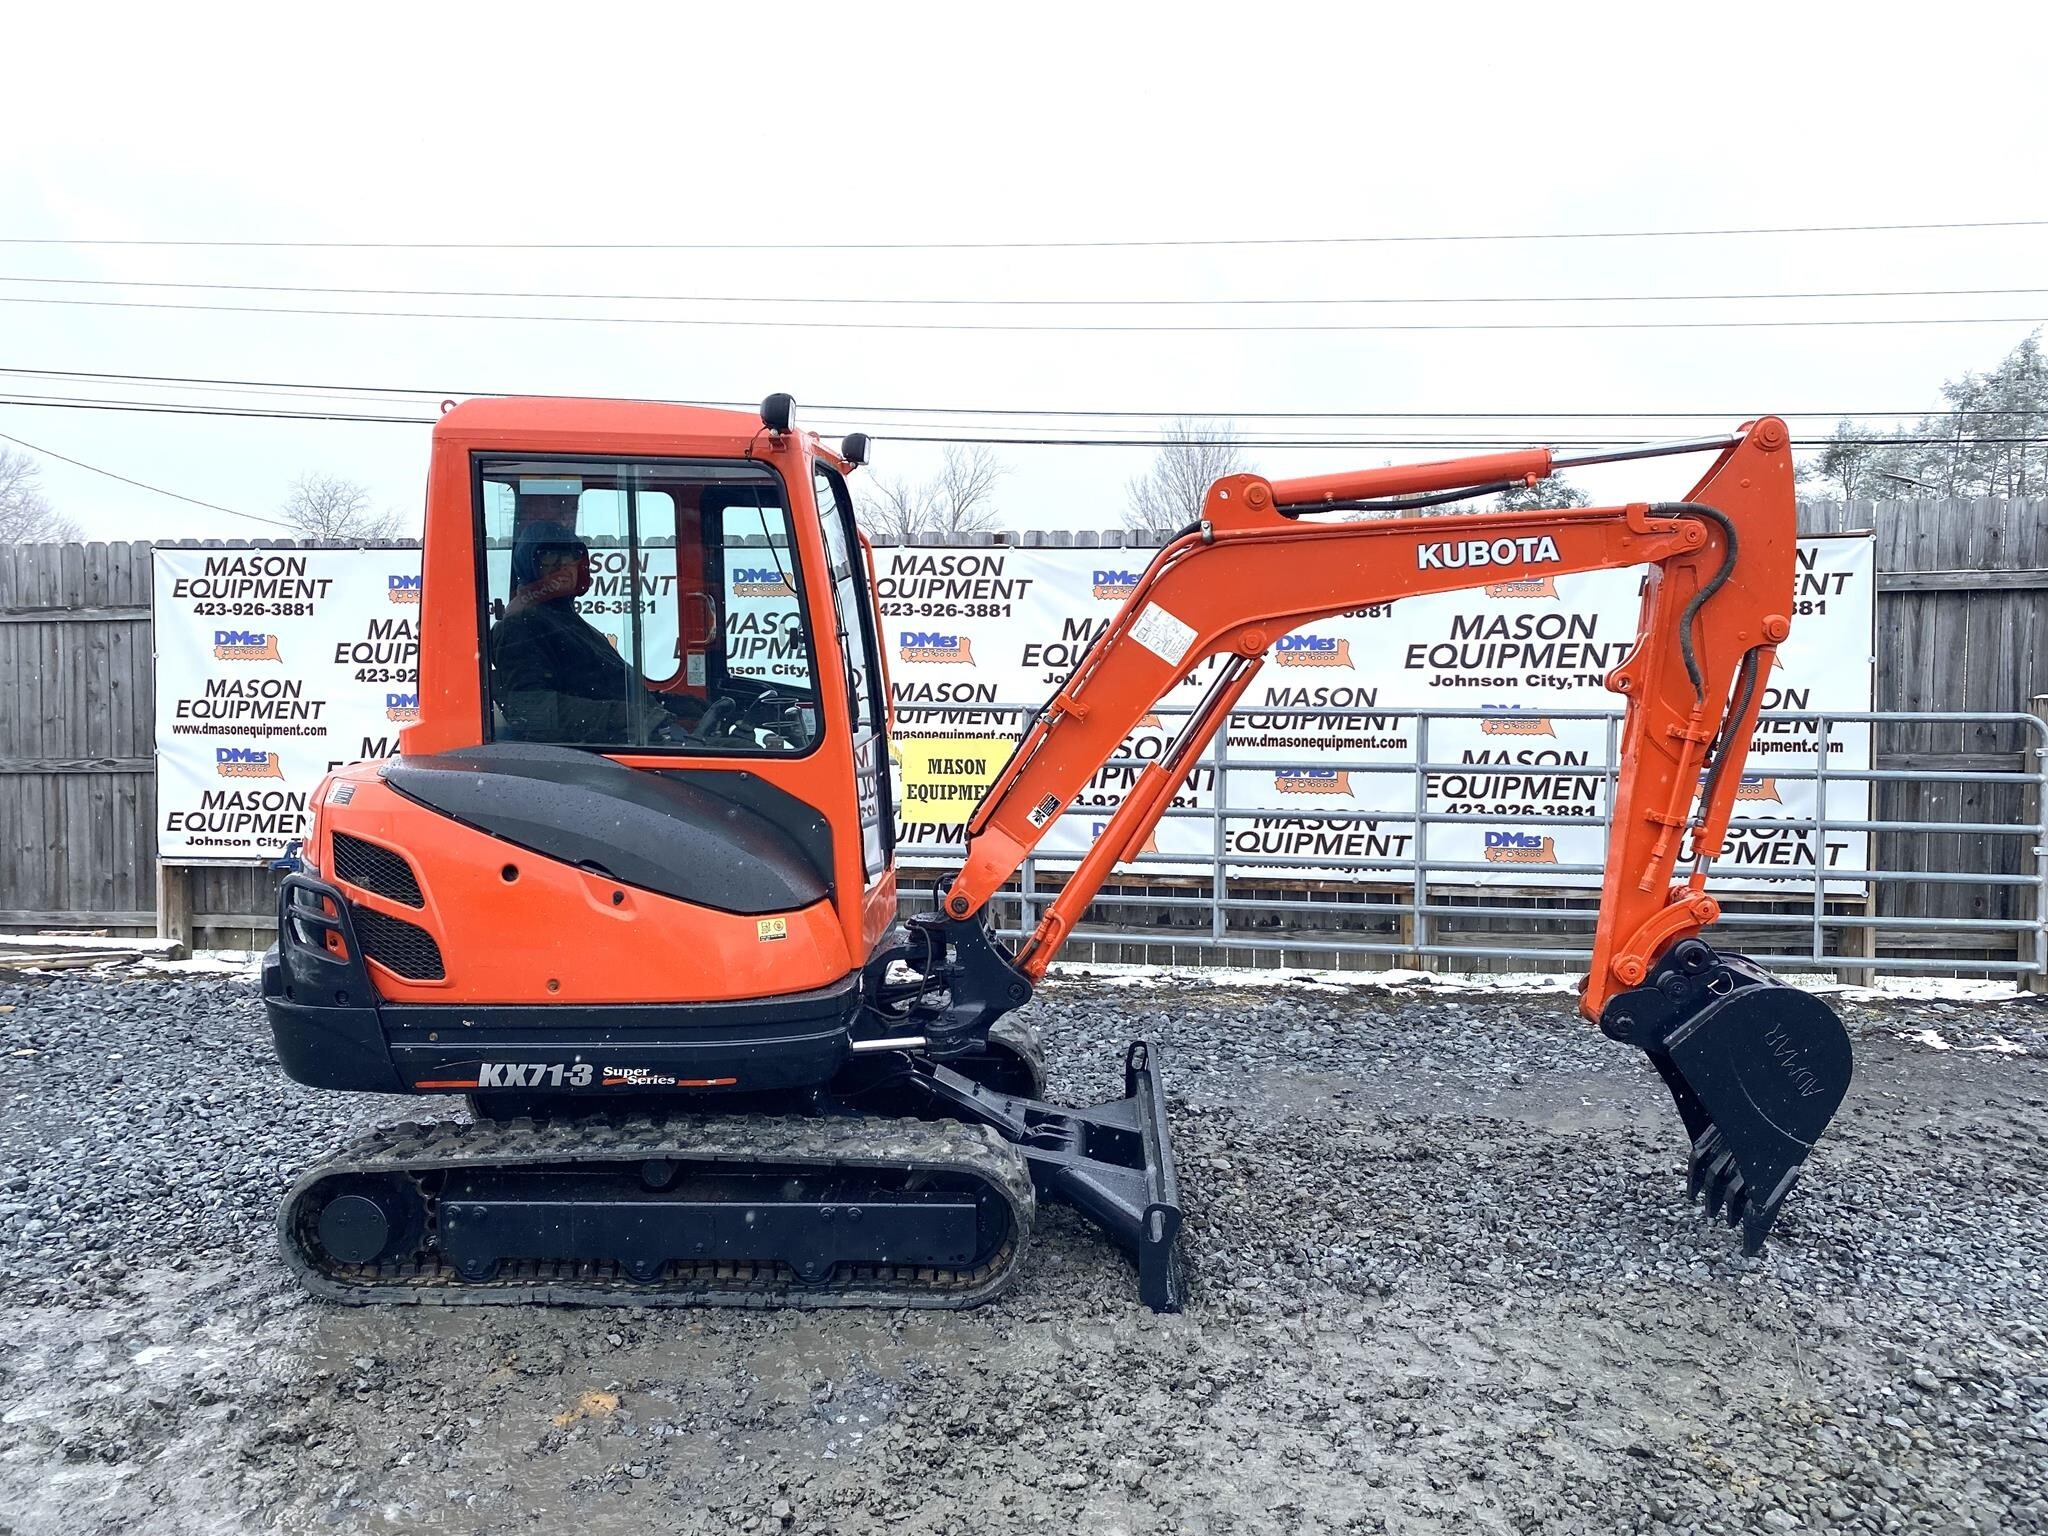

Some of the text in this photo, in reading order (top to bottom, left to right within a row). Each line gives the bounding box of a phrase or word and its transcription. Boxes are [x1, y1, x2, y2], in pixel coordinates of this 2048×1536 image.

[1417, 536, 1560, 569] KUBOTA
[204, 556, 307, 577] MASON
[890, 555, 1005, 576] MASON
[172, 578, 333, 600] EQUIPMENT
[193, 602, 315, 616] 423-926-3881
[880, 602, 1012, 617] 423-926-3881
[1449, 613, 1598, 641] MASON
[334, 642, 418, 664] EQUIP
[1404, 642, 1635, 669] EQUIPMENT
[354, 668, 417, 683] 423-92
[1428, 674, 1518, 687] Johnson
[204, 679, 303, 699] MASON
[891, 682, 998, 704] MASON
[1264, 687, 1378, 708] MASON
[175, 699, 326, 720] EQUIPMENT
[172, 722, 328, 738] www.dmasonequipment.com
[1226, 733, 1408, 751] www.dmasonequipment.com
[928, 758, 987, 776] MASON
[200, 790, 307, 812] MASON
[906, 783, 991, 803] EQUIPME
[185, 836, 251, 847] Johnson
[478, 1063, 650, 1088] KX71-3 Super
[627, 1075, 676, 1085] Series
